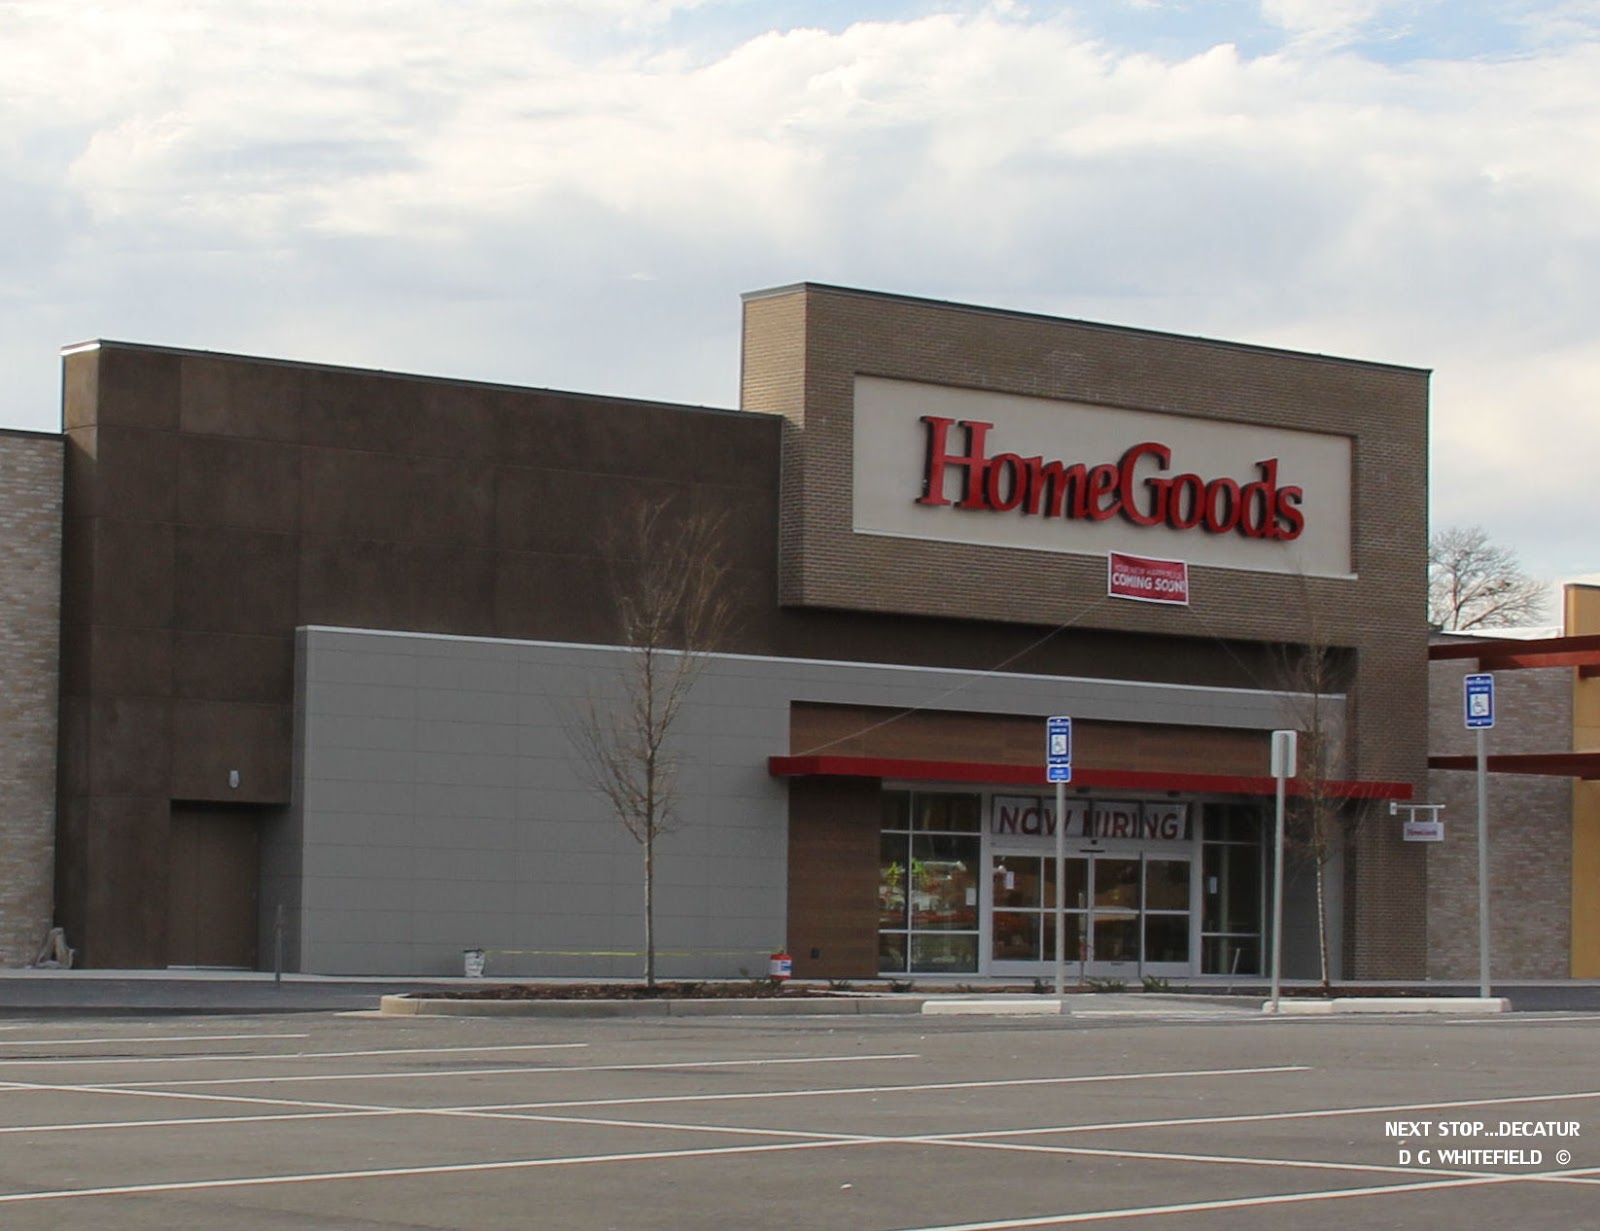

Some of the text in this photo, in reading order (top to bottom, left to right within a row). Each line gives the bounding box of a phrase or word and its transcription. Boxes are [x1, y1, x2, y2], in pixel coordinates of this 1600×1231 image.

[915, 414, 1304, 541] HomeGoods
[1112, 572, 1153, 590] COMING
[1000, 806, 1179, 840] NOW HIRING
